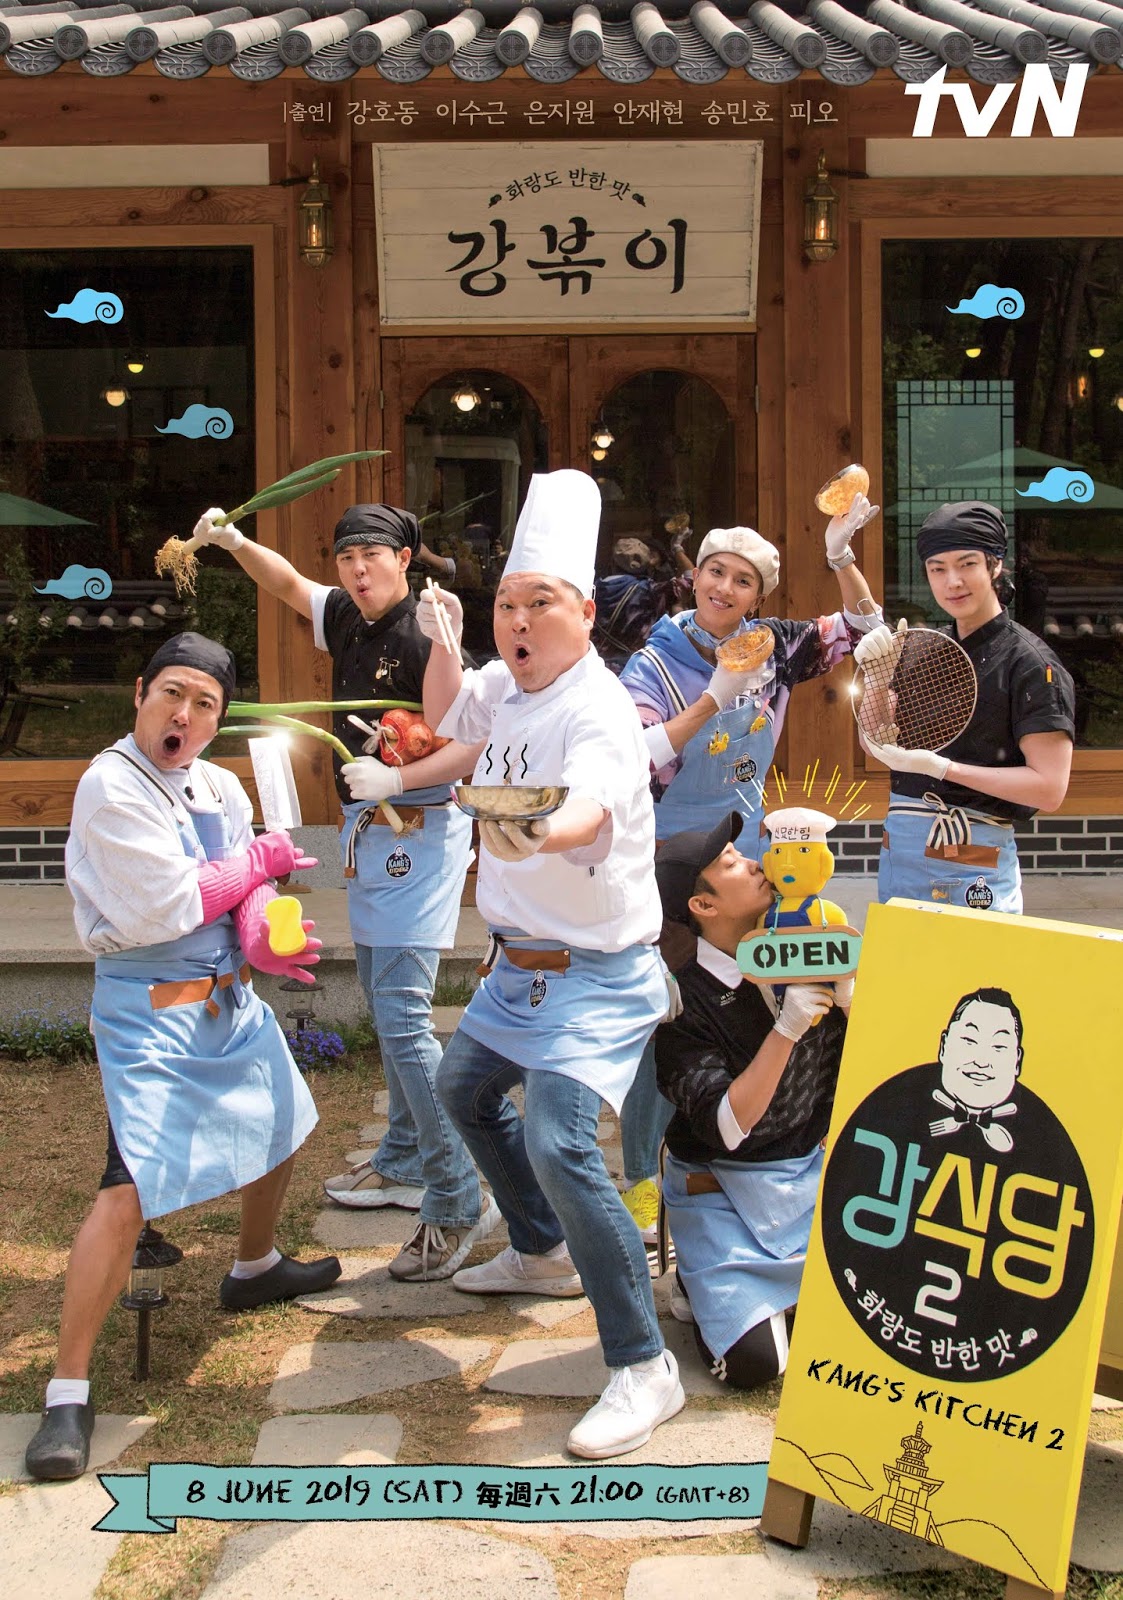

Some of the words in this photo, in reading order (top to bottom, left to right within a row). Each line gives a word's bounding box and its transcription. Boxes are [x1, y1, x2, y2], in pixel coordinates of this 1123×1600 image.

[505, 170, 563, 202] 화랑도
[568, 167, 608, 191] 반한
[609, 179, 632, 201] 맛
[445, 215, 689, 297] 강볶이
[752, 939, 851, 970] OPEN
[841, 1127, 1086, 1300] 강식당
[857, 1289, 922, 1356] 화랑도
[930, 1336, 982, 1372] 반한
[985, 1328, 1016, 1368] 맛
[914, 1260, 963, 1327] 2
[806, 1358, 907, 1404] KANG'S
[1045, 1426, 1066, 1452] 2
